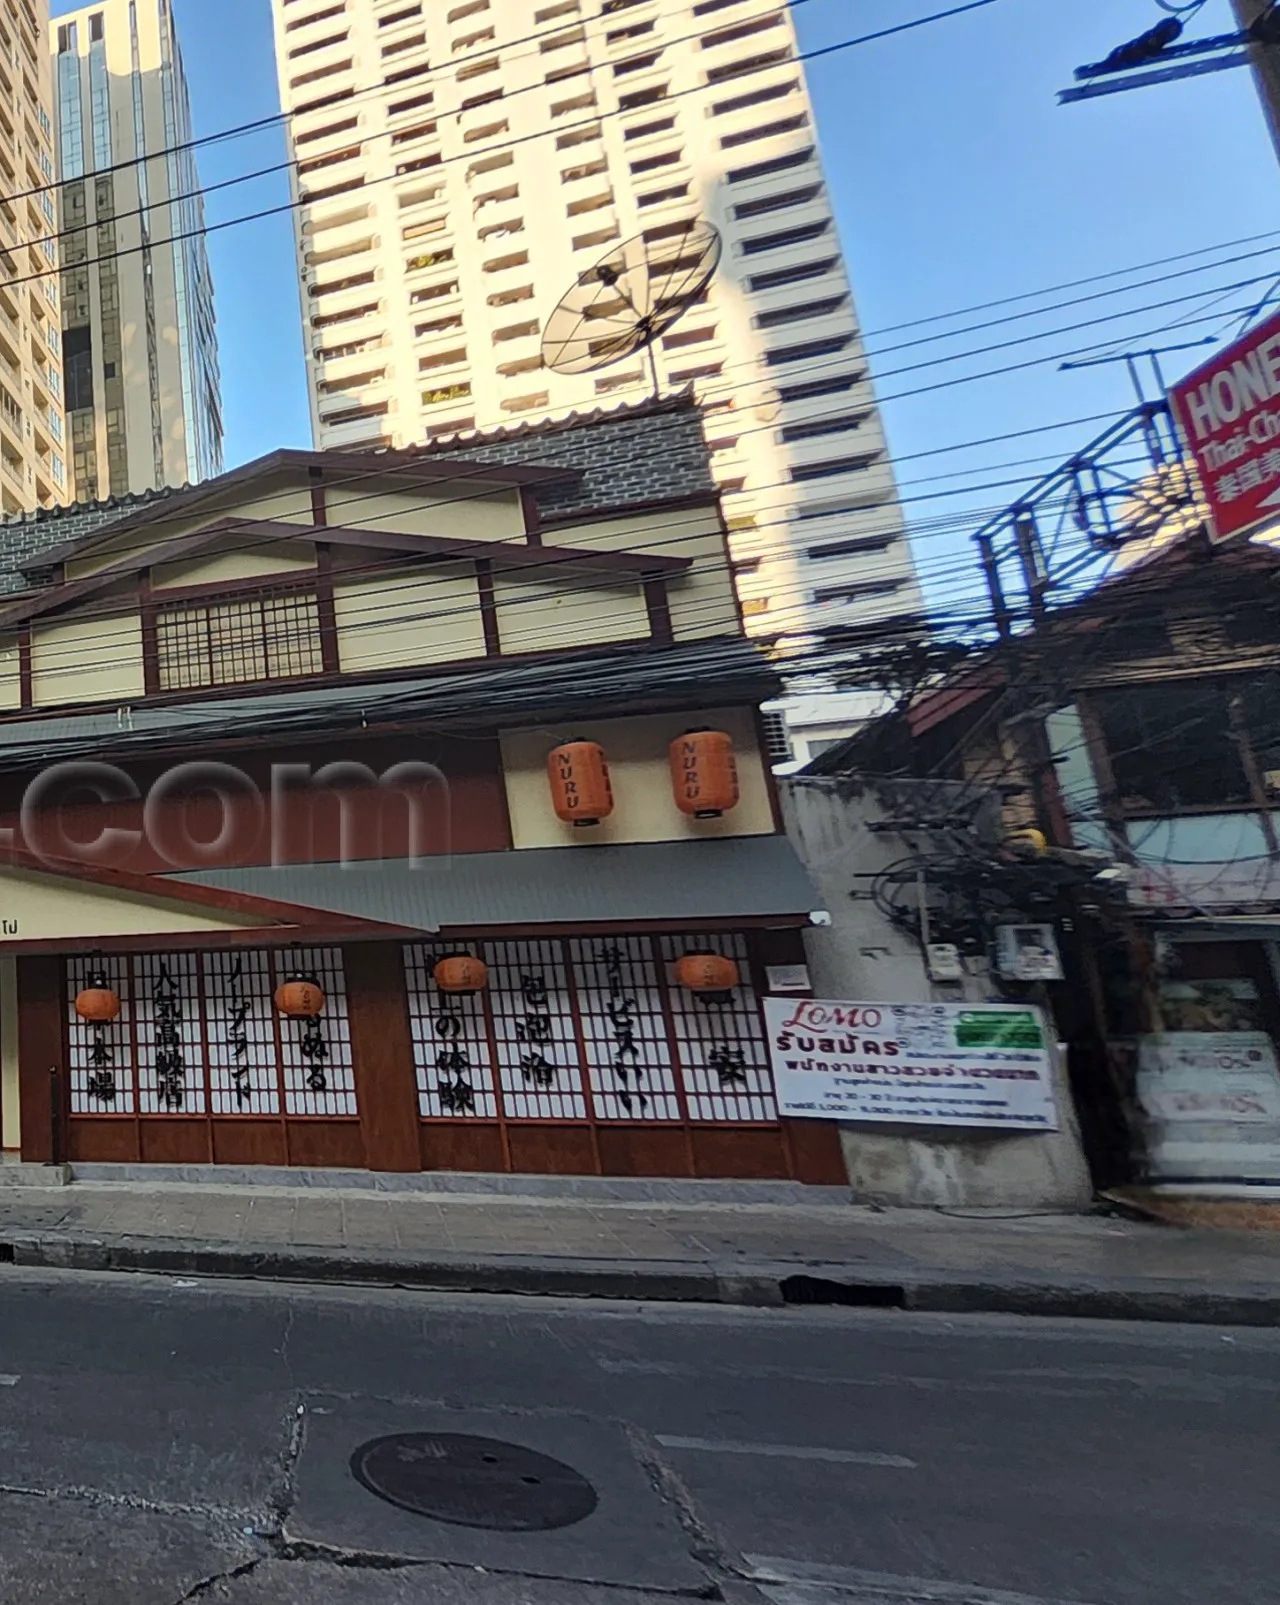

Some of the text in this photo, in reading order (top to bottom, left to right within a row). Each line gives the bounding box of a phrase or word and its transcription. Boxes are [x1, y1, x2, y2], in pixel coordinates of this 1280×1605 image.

[557, 753, 579, 809] NURU
[681, 742, 700, 799] NURU
[780, 1000, 882, 1034] LOMO
[776, 1029, 901, 1057] รับสมัคร
